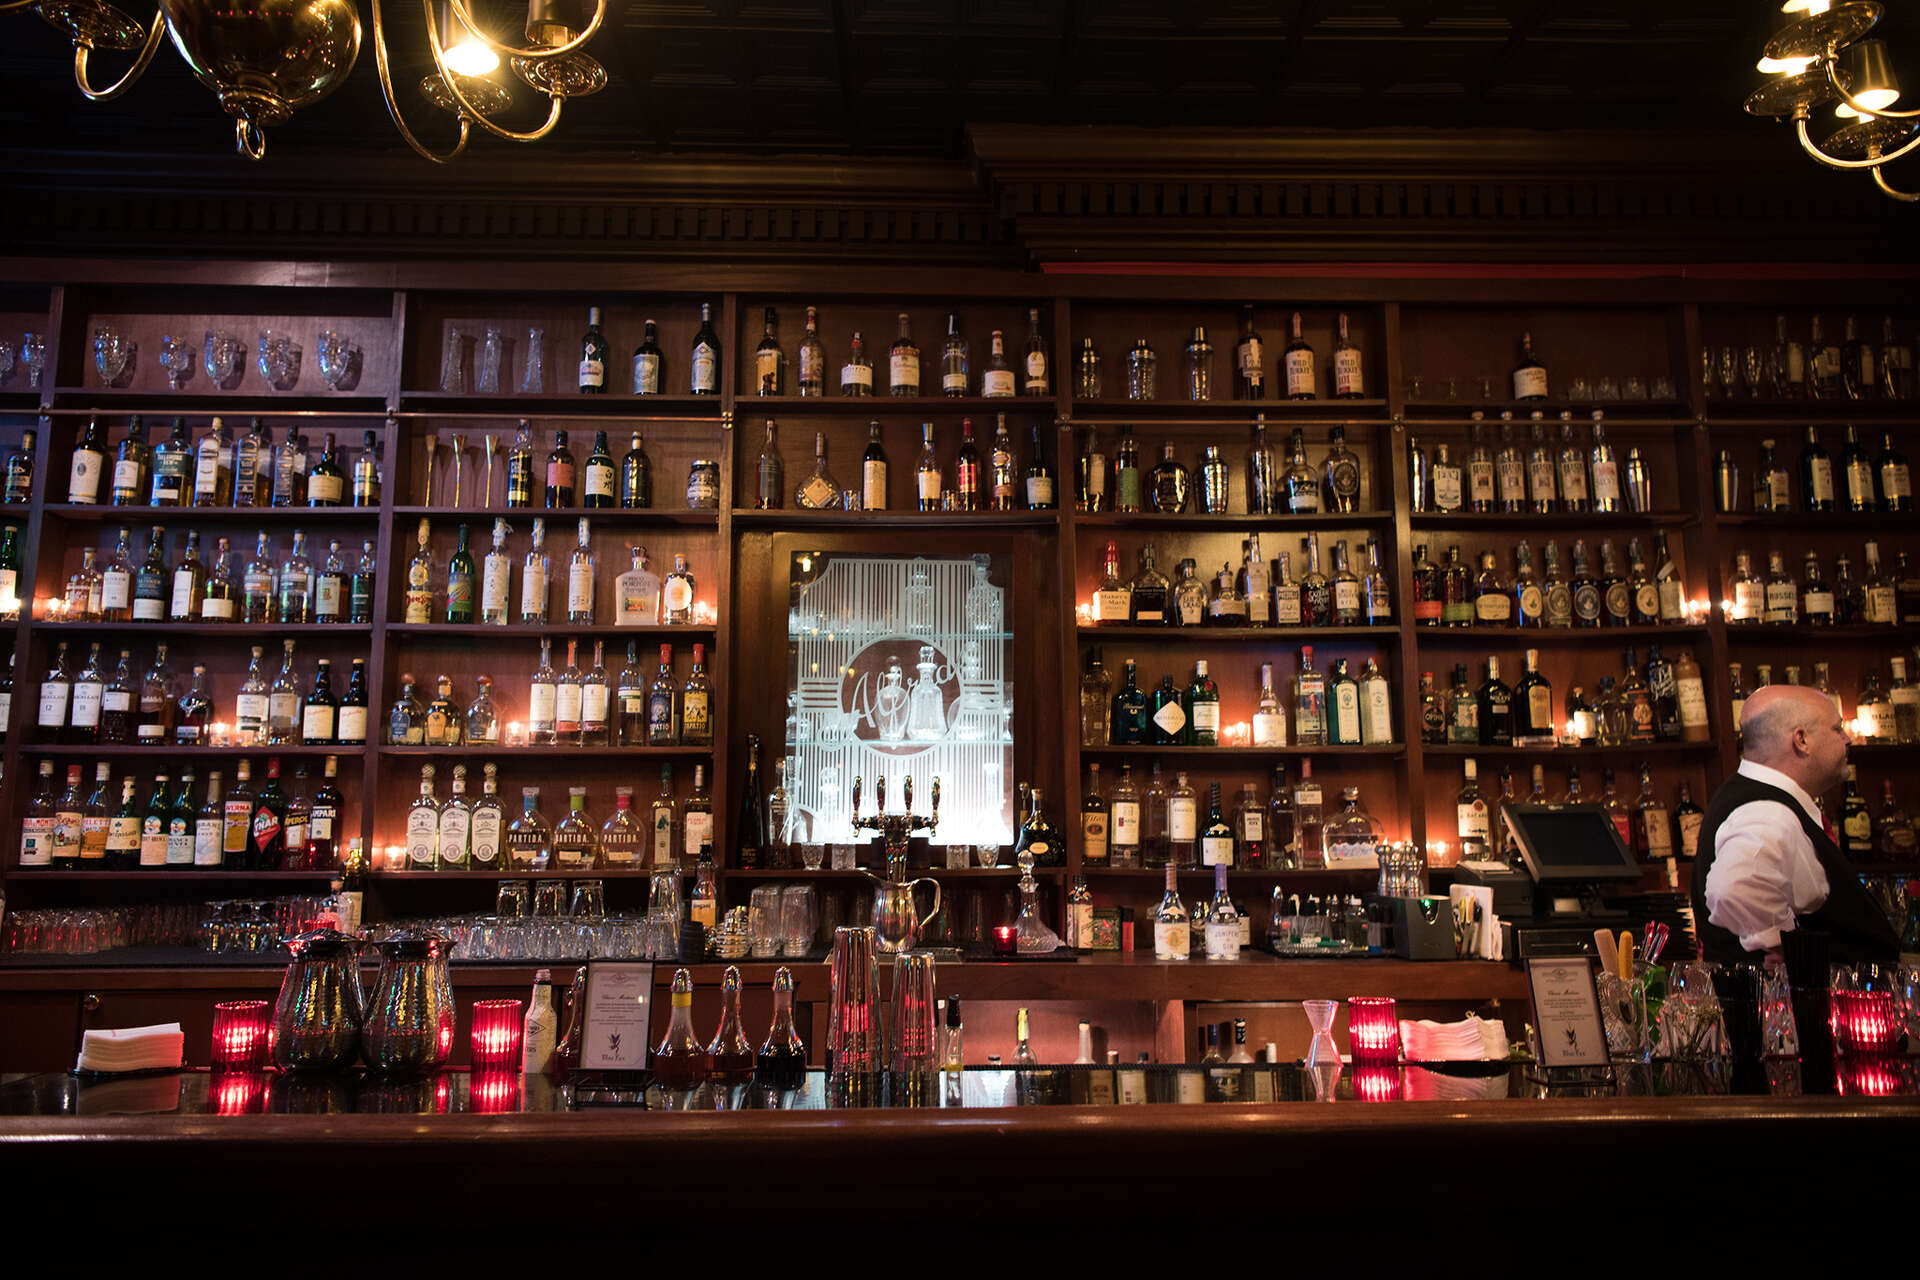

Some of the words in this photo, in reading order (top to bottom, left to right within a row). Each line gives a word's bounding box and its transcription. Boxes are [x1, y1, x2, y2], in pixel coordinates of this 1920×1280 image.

[1292, 359, 1307, 367] WILD
[1340, 359, 1356, 367] WILD
[1290, 366, 1311, 374] TURKEY
[1338, 366, 1359, 374] TURKEY
[1339, 375, 1351, 385] 101
[508, 834, 543, 843] PARTIDA
[604, 834, 638, 843] PARTIDA
